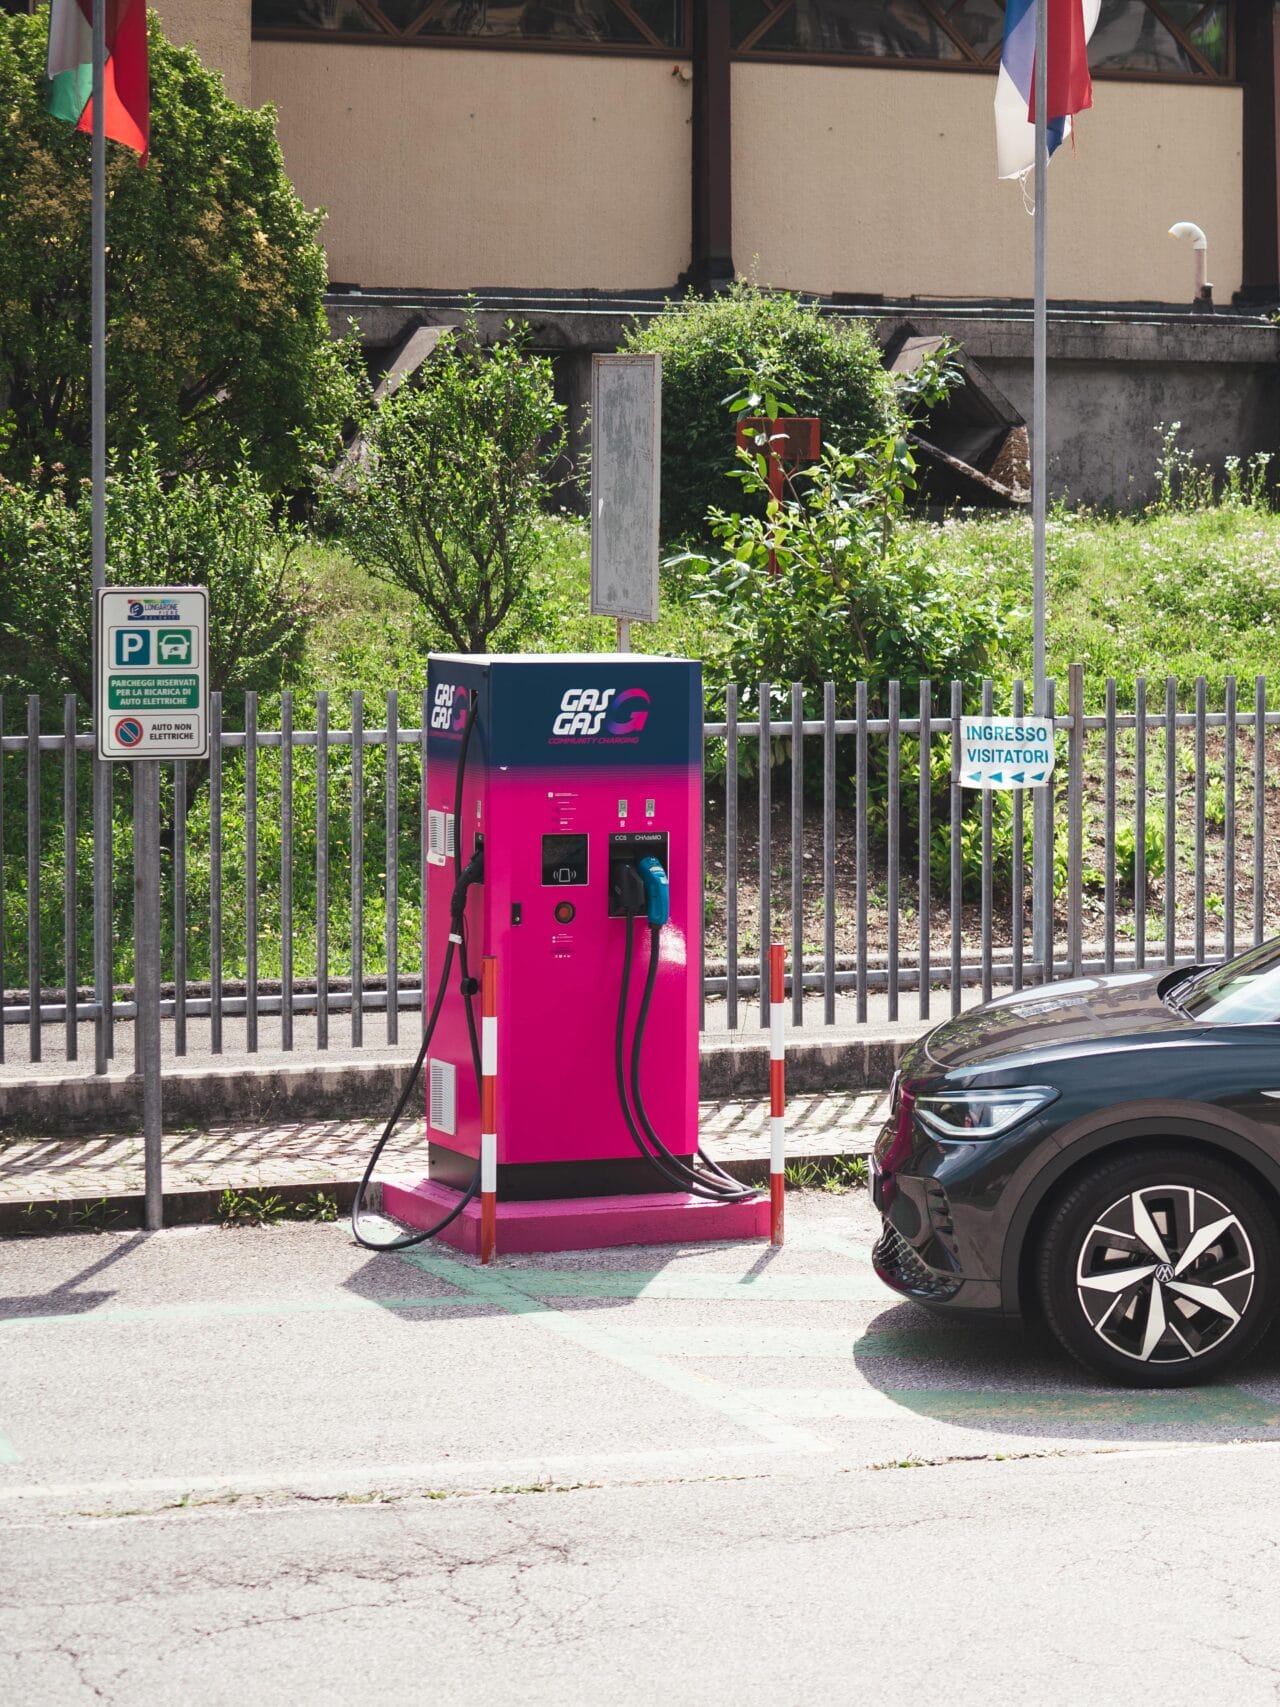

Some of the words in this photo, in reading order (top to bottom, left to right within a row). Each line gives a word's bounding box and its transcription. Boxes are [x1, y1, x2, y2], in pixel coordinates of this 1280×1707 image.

[122, 633, 144, 662] P
[111, 679, 155, 687] PARCHEGGI
[156, 678, 196, 686] RISERVATI
[116, 688, 130, 696] PER
[132, 688, 142, 696] LA
[144, 688, 180, 696] RICARICA
[182, 687, 191, 696] DI
[434, 683, 456, 707] GAS
[143, 697, 188, 705] ELETTRICHE
[560, 688, 616, 712] GAS
[431, 706, 453, 730] GAS
[552, 711, 607, 735] GAS
[151, 723, 173, 731] AUTO
[966, 725, 1047, 742] INGRESSO
[149, 732, 194, 740] ELETTRICHE
[548, 736, 598, 745] COMMUNITY
[967, 748, 1049, 764] VISITATORI
